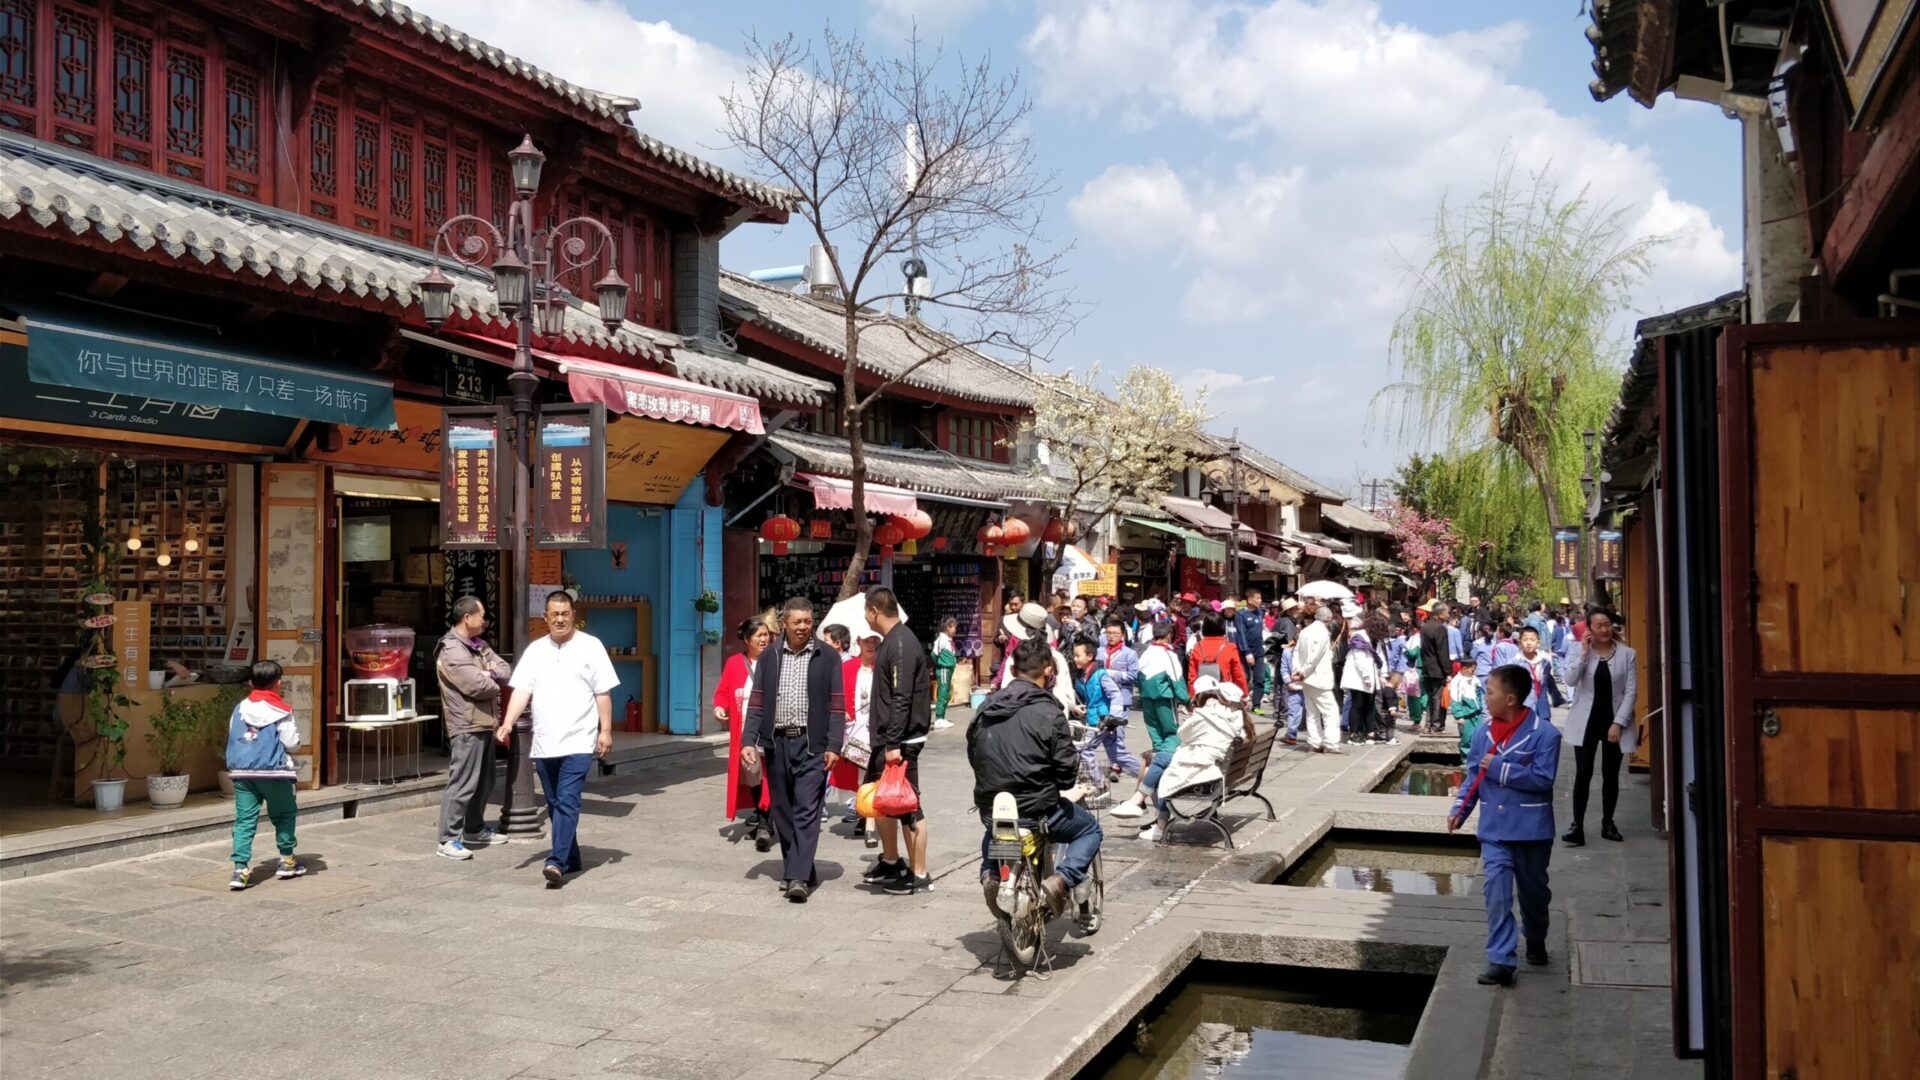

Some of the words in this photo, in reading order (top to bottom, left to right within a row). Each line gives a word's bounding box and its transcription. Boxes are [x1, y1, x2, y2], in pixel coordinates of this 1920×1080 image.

[457, 373, 482, 393] 213
[88, 410, 96, 418] 3
[98, 411, 126, 422] Cards
[129, 414, 159, 425] Studio
[550, 453, 562, 500] 创建5A景区
[571, 458, 582, 523] 从文明旅游开始
[124, 607, 140, 681] 三生有信
